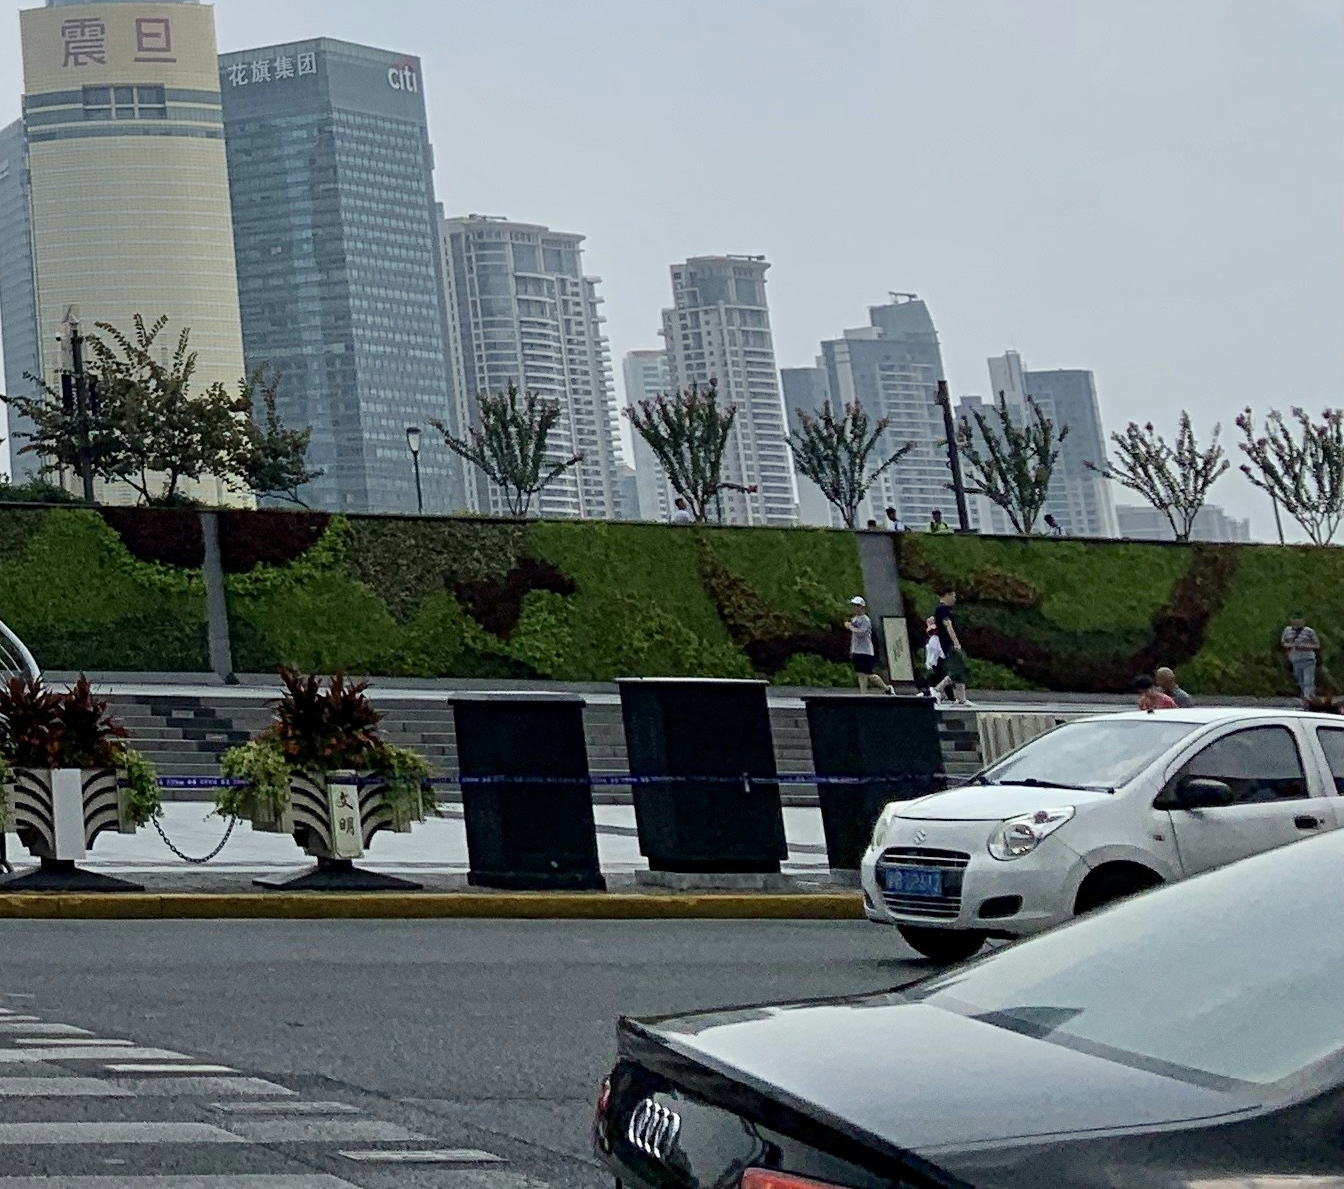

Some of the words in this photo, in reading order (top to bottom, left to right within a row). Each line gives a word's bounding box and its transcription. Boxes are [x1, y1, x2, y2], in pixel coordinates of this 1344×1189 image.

[61, 18, 177, 67] 震旦
[228, 52, 317, 87] 花旗集团
[337, 791, 355, 836] 文明
